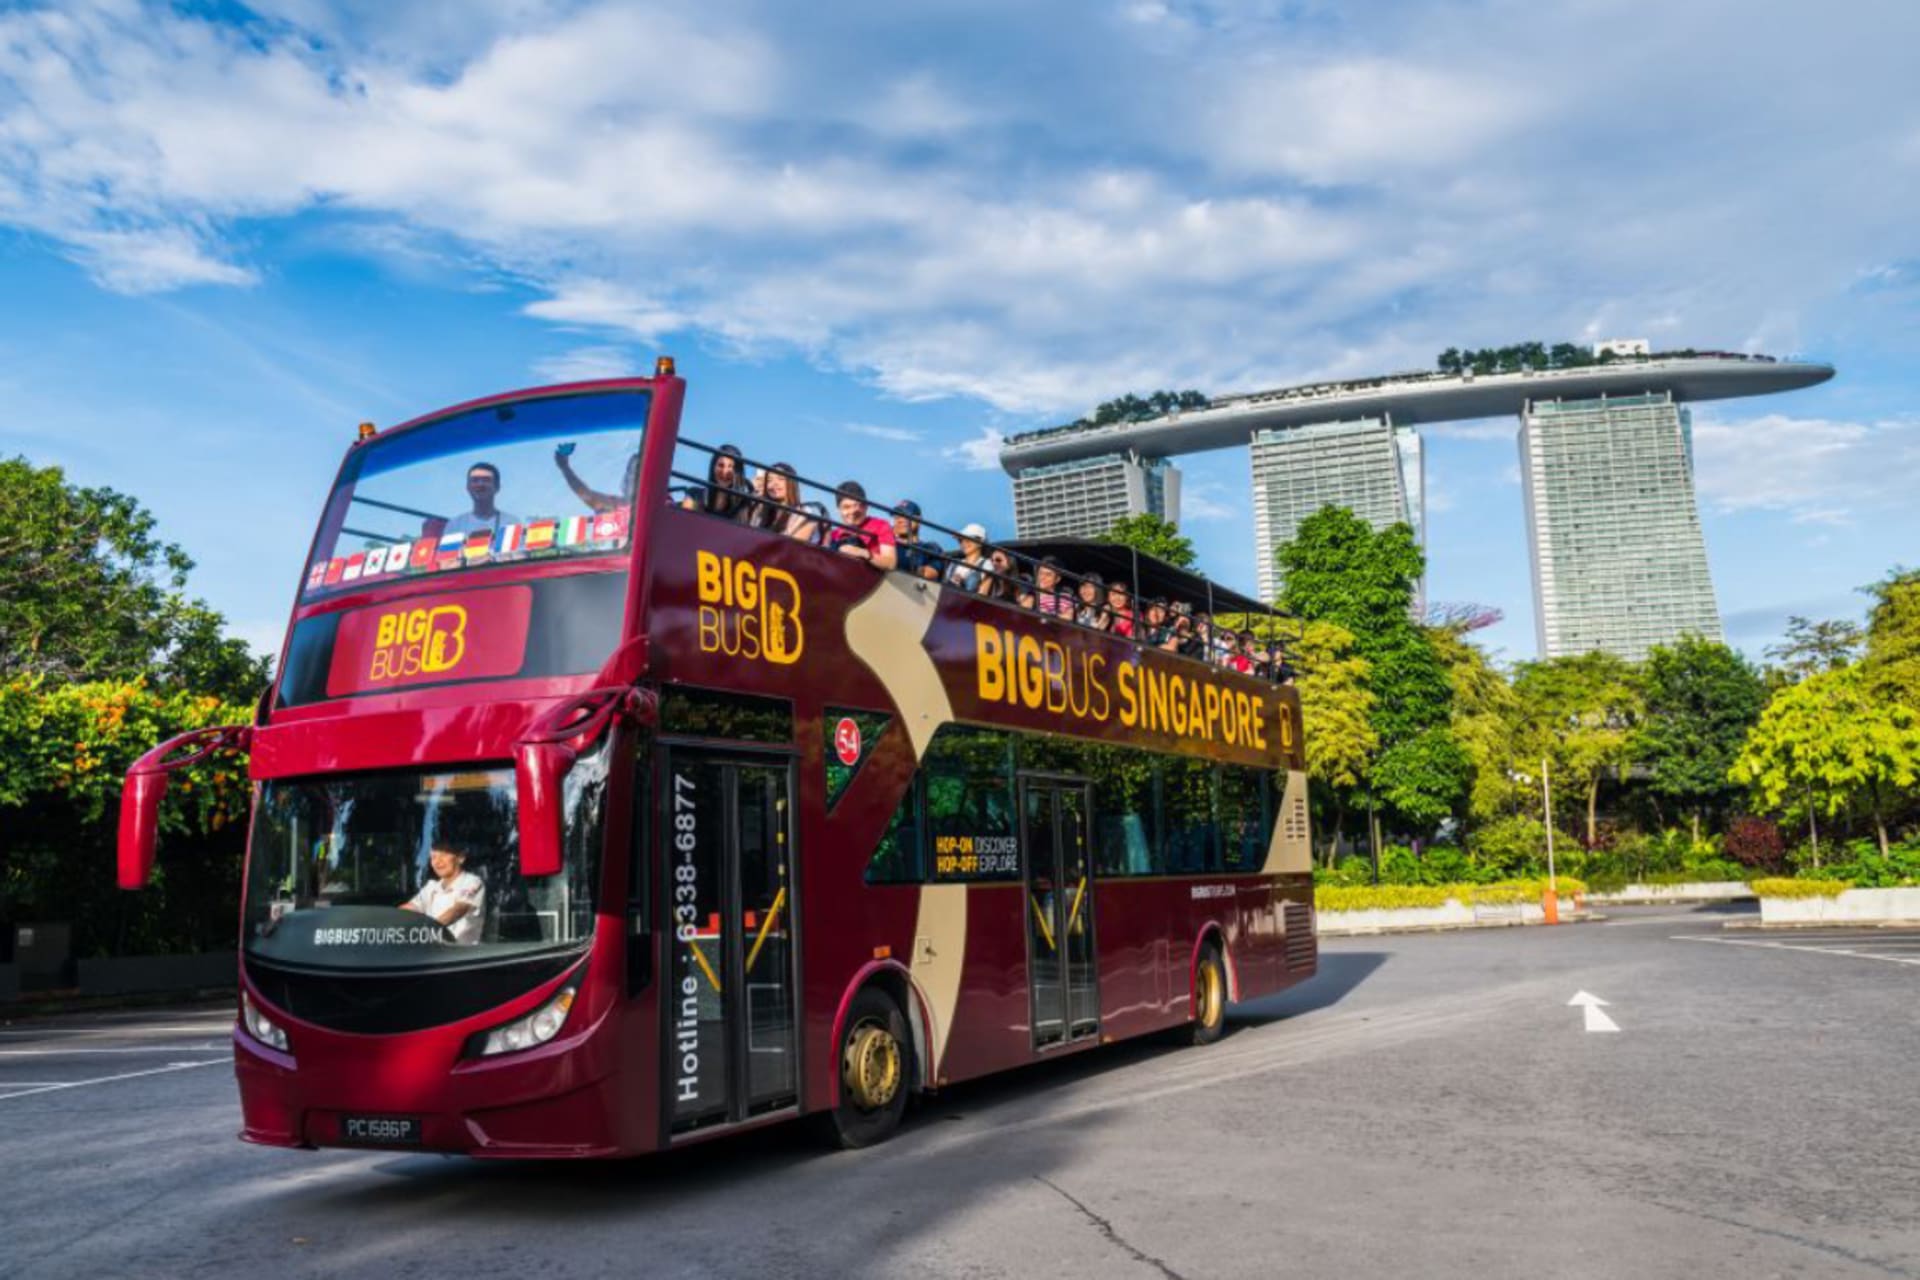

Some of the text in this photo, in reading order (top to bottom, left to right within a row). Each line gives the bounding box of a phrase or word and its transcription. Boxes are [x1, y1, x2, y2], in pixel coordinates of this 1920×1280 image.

[697, 549, 757, 610] BIG
[376, 609, 426, 647] BIG
[700, 606, 760, 659] BUS
[370, 645, 423, 681] BUS
[1117, 661, 1267, 750] SINGAPORE
[839, 729, 858, 754] 54
[674, 774, 698, 942] 6338-6877
[936, 836, 1017, 853] HOP-ON DISCOVER
[937, 855, 978, 873] HOP-OFF
[314, 927, 443, 945] BIGBUSTOURS.COM
[677, 975, 699, 1102] Hotline
